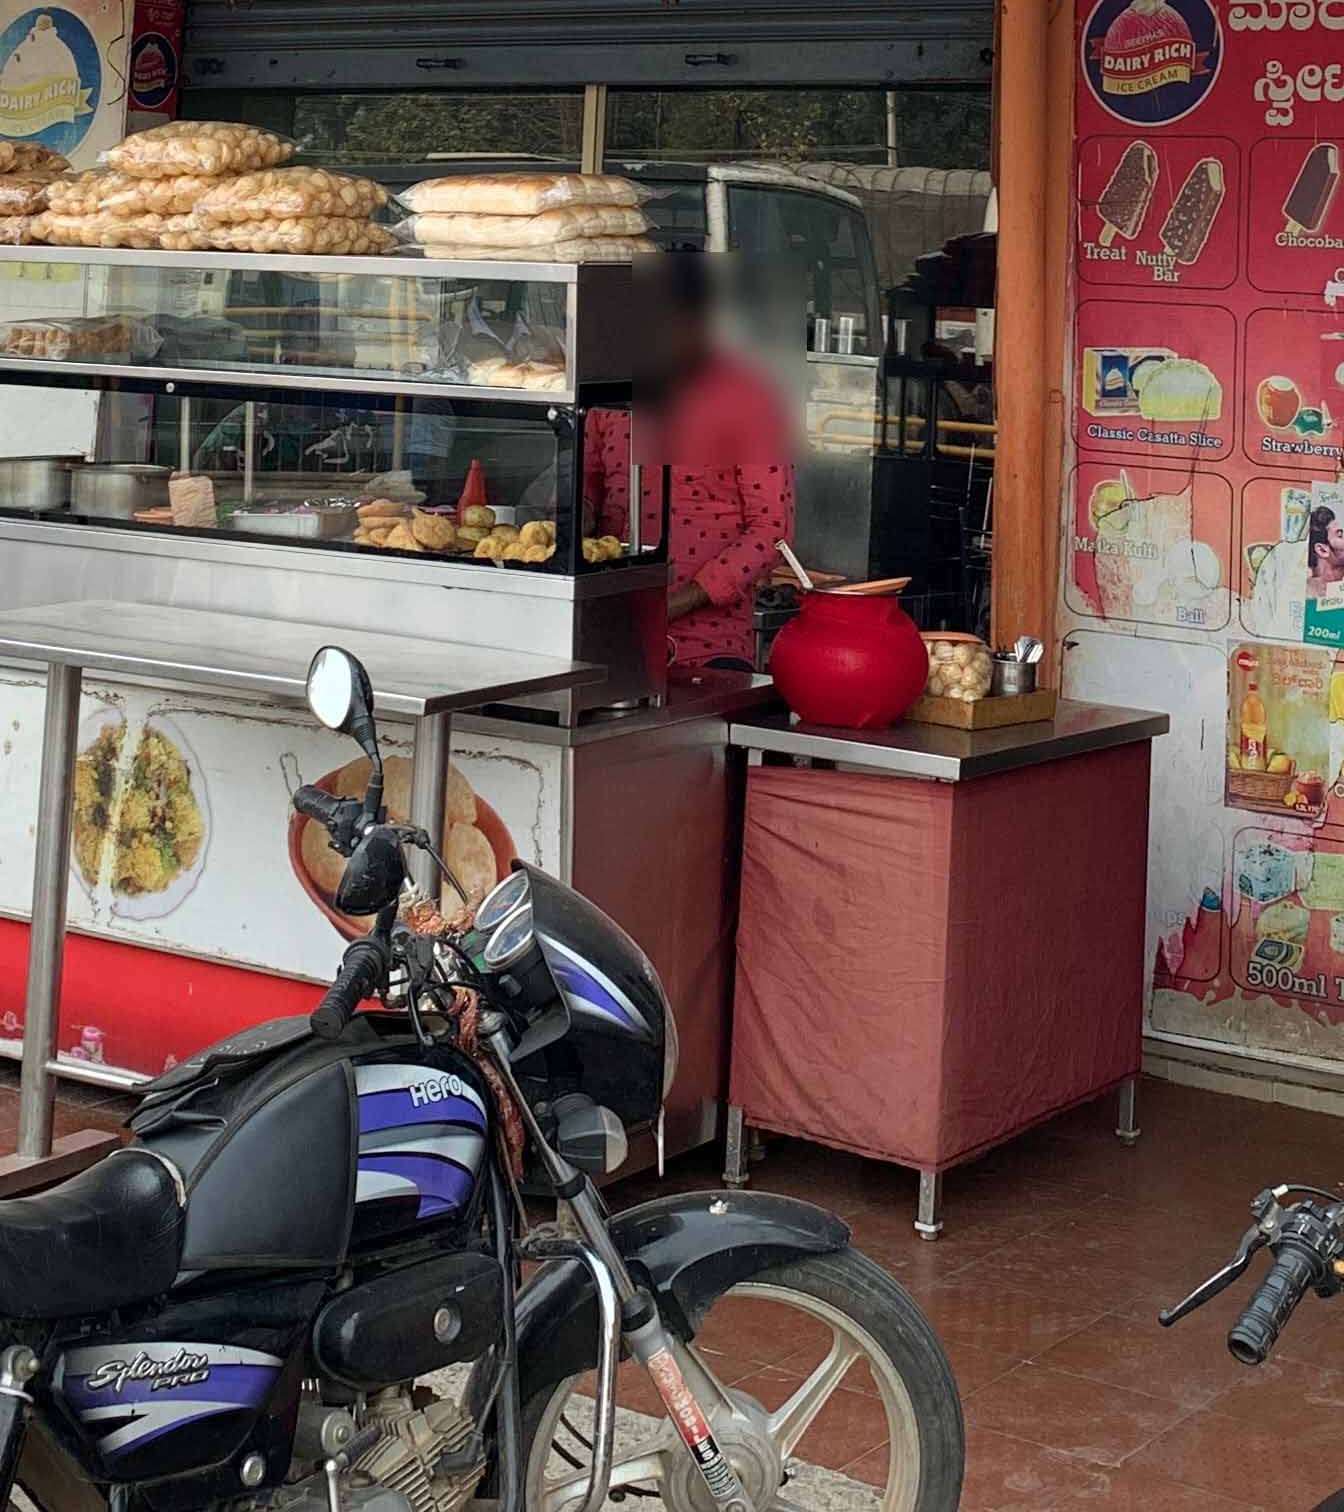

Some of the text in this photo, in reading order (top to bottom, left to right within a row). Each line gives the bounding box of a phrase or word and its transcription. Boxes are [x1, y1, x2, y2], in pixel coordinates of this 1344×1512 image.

[1103, 42, 1192, 72] DAIRY RICH
[1116, 69, 1178, 93] ICE CREAM
[1083, 243, 1127, 261] Treat
[1135, 249, 1178, 271] Nutty
[1152, 266, 1180, 283] Bar
[1087, 424, 1134, 441] Classic
[1189, 431, 1223, 448] Slice
[1307, 625, 1341, 640] 200ml
[1247, 963, 1328, 999] 500ml
[409, 1074, 462, 1107] Hero
[88, 1347, 208, 1392] Splendor
[152, 1369, 209, 1391] PRO
